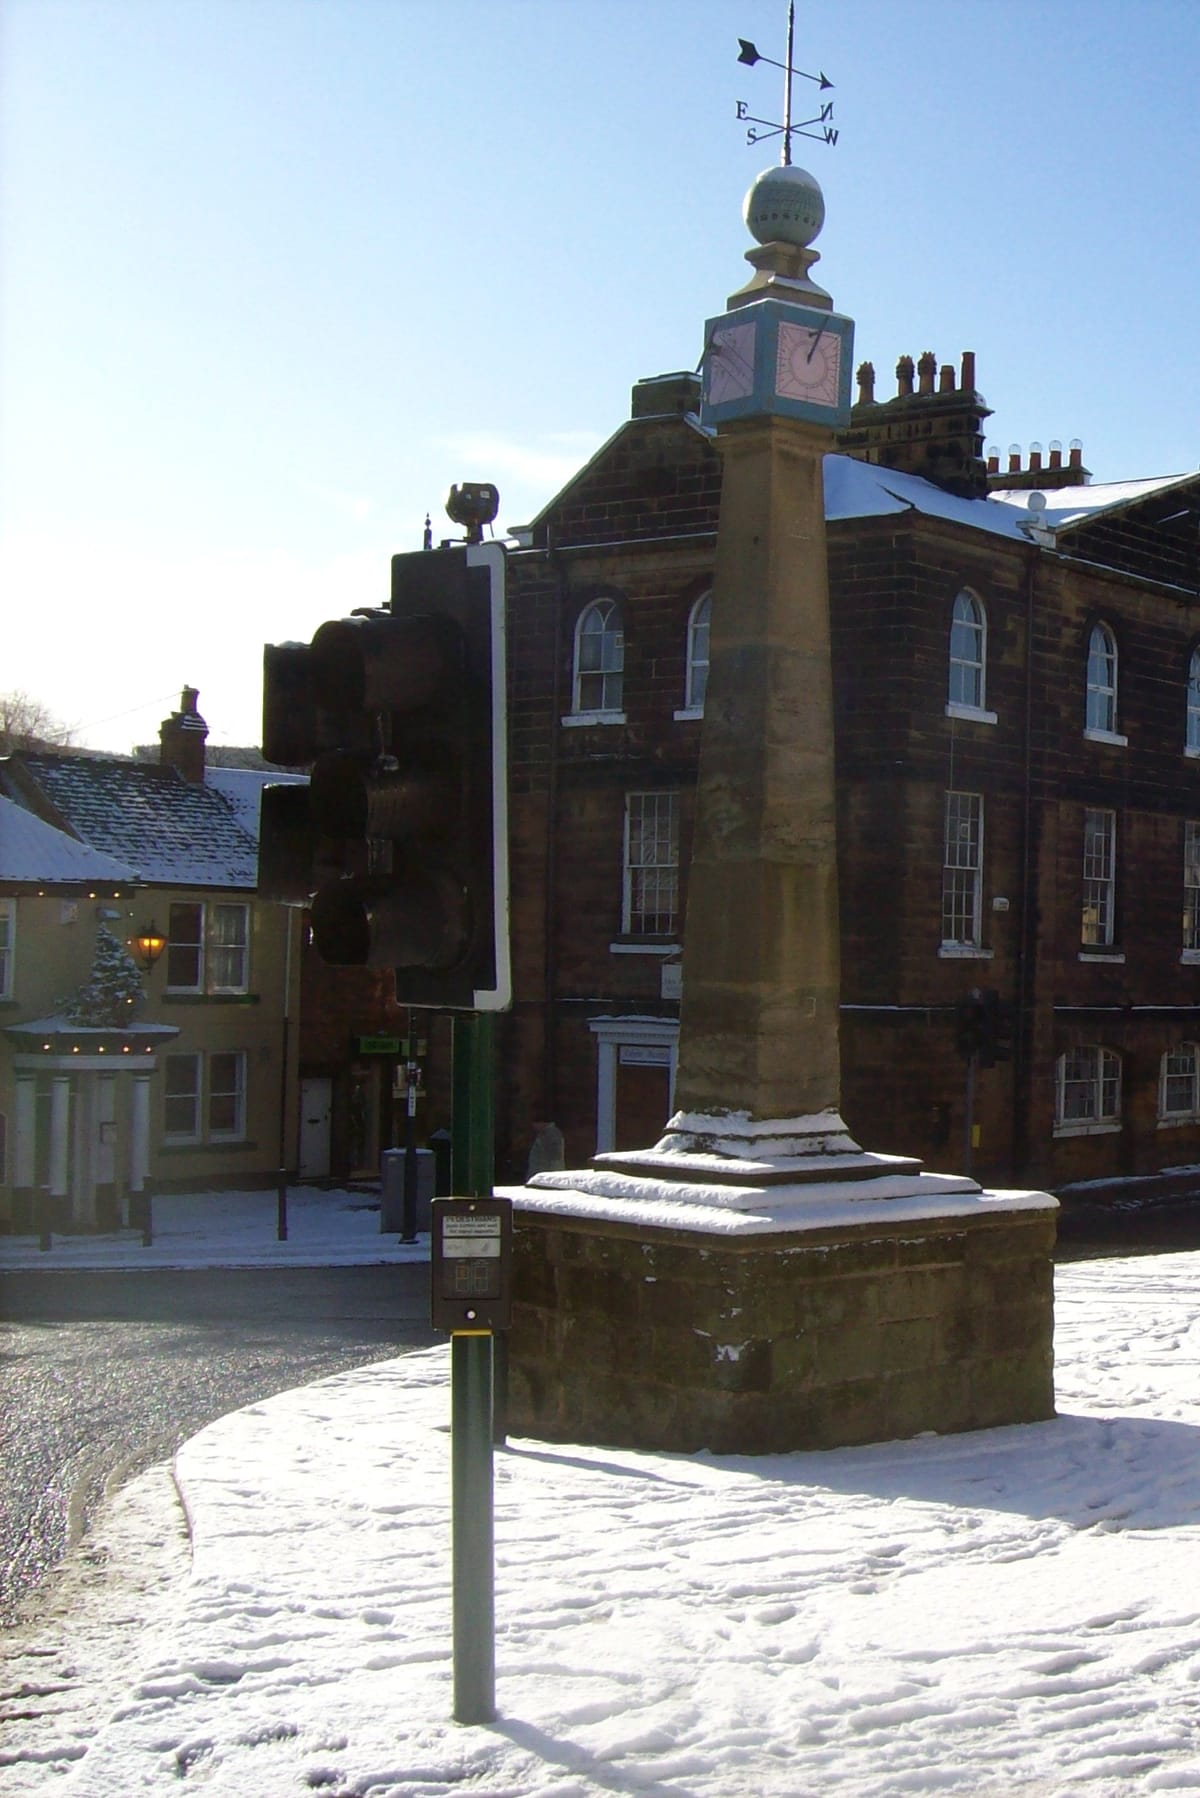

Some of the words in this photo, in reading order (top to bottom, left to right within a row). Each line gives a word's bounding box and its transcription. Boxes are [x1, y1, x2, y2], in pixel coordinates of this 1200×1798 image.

[736, 100, 748, 120] E
[746, 127, 757, 146] S
[823, 126, 839, 147] W
